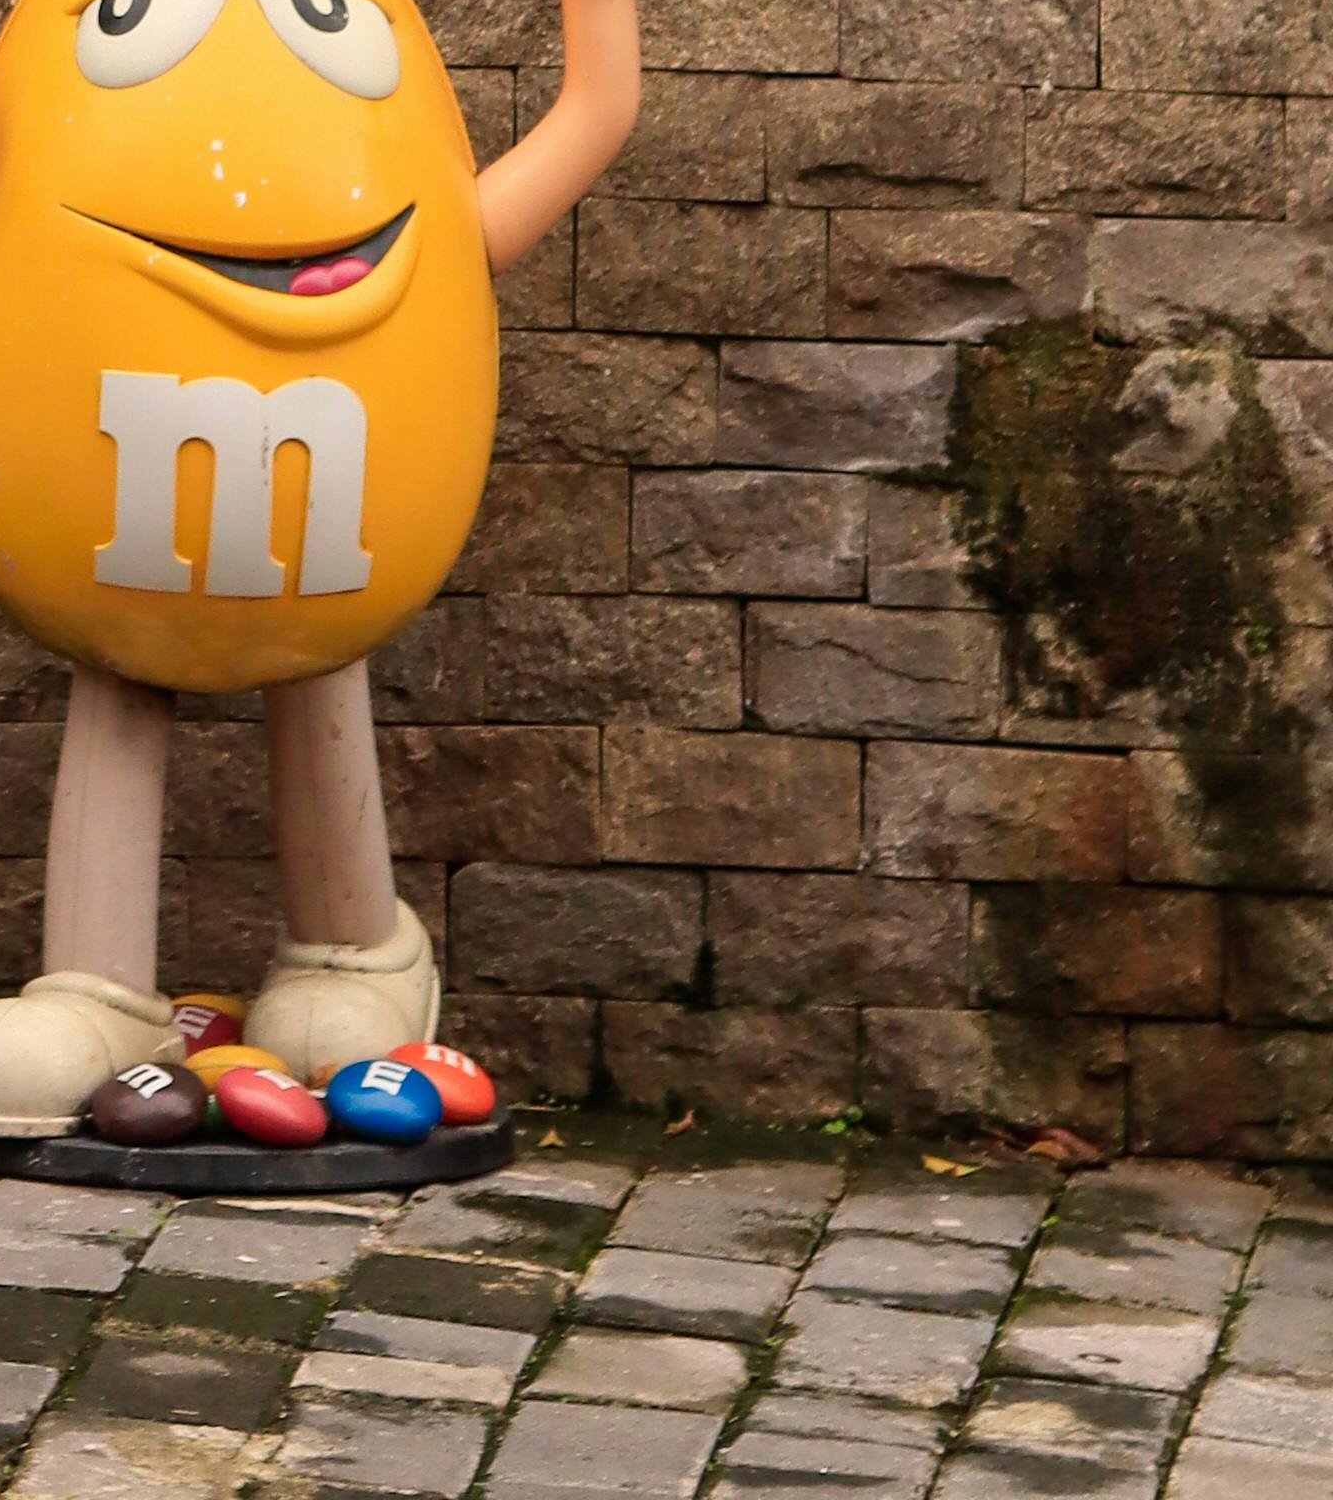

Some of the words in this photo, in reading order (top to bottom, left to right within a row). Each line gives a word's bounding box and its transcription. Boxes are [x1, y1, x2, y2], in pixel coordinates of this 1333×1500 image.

[93, 369, 373, 599] m
[117, 1062, 174, 1100] m
[360, 1059, 412, 1097] m
